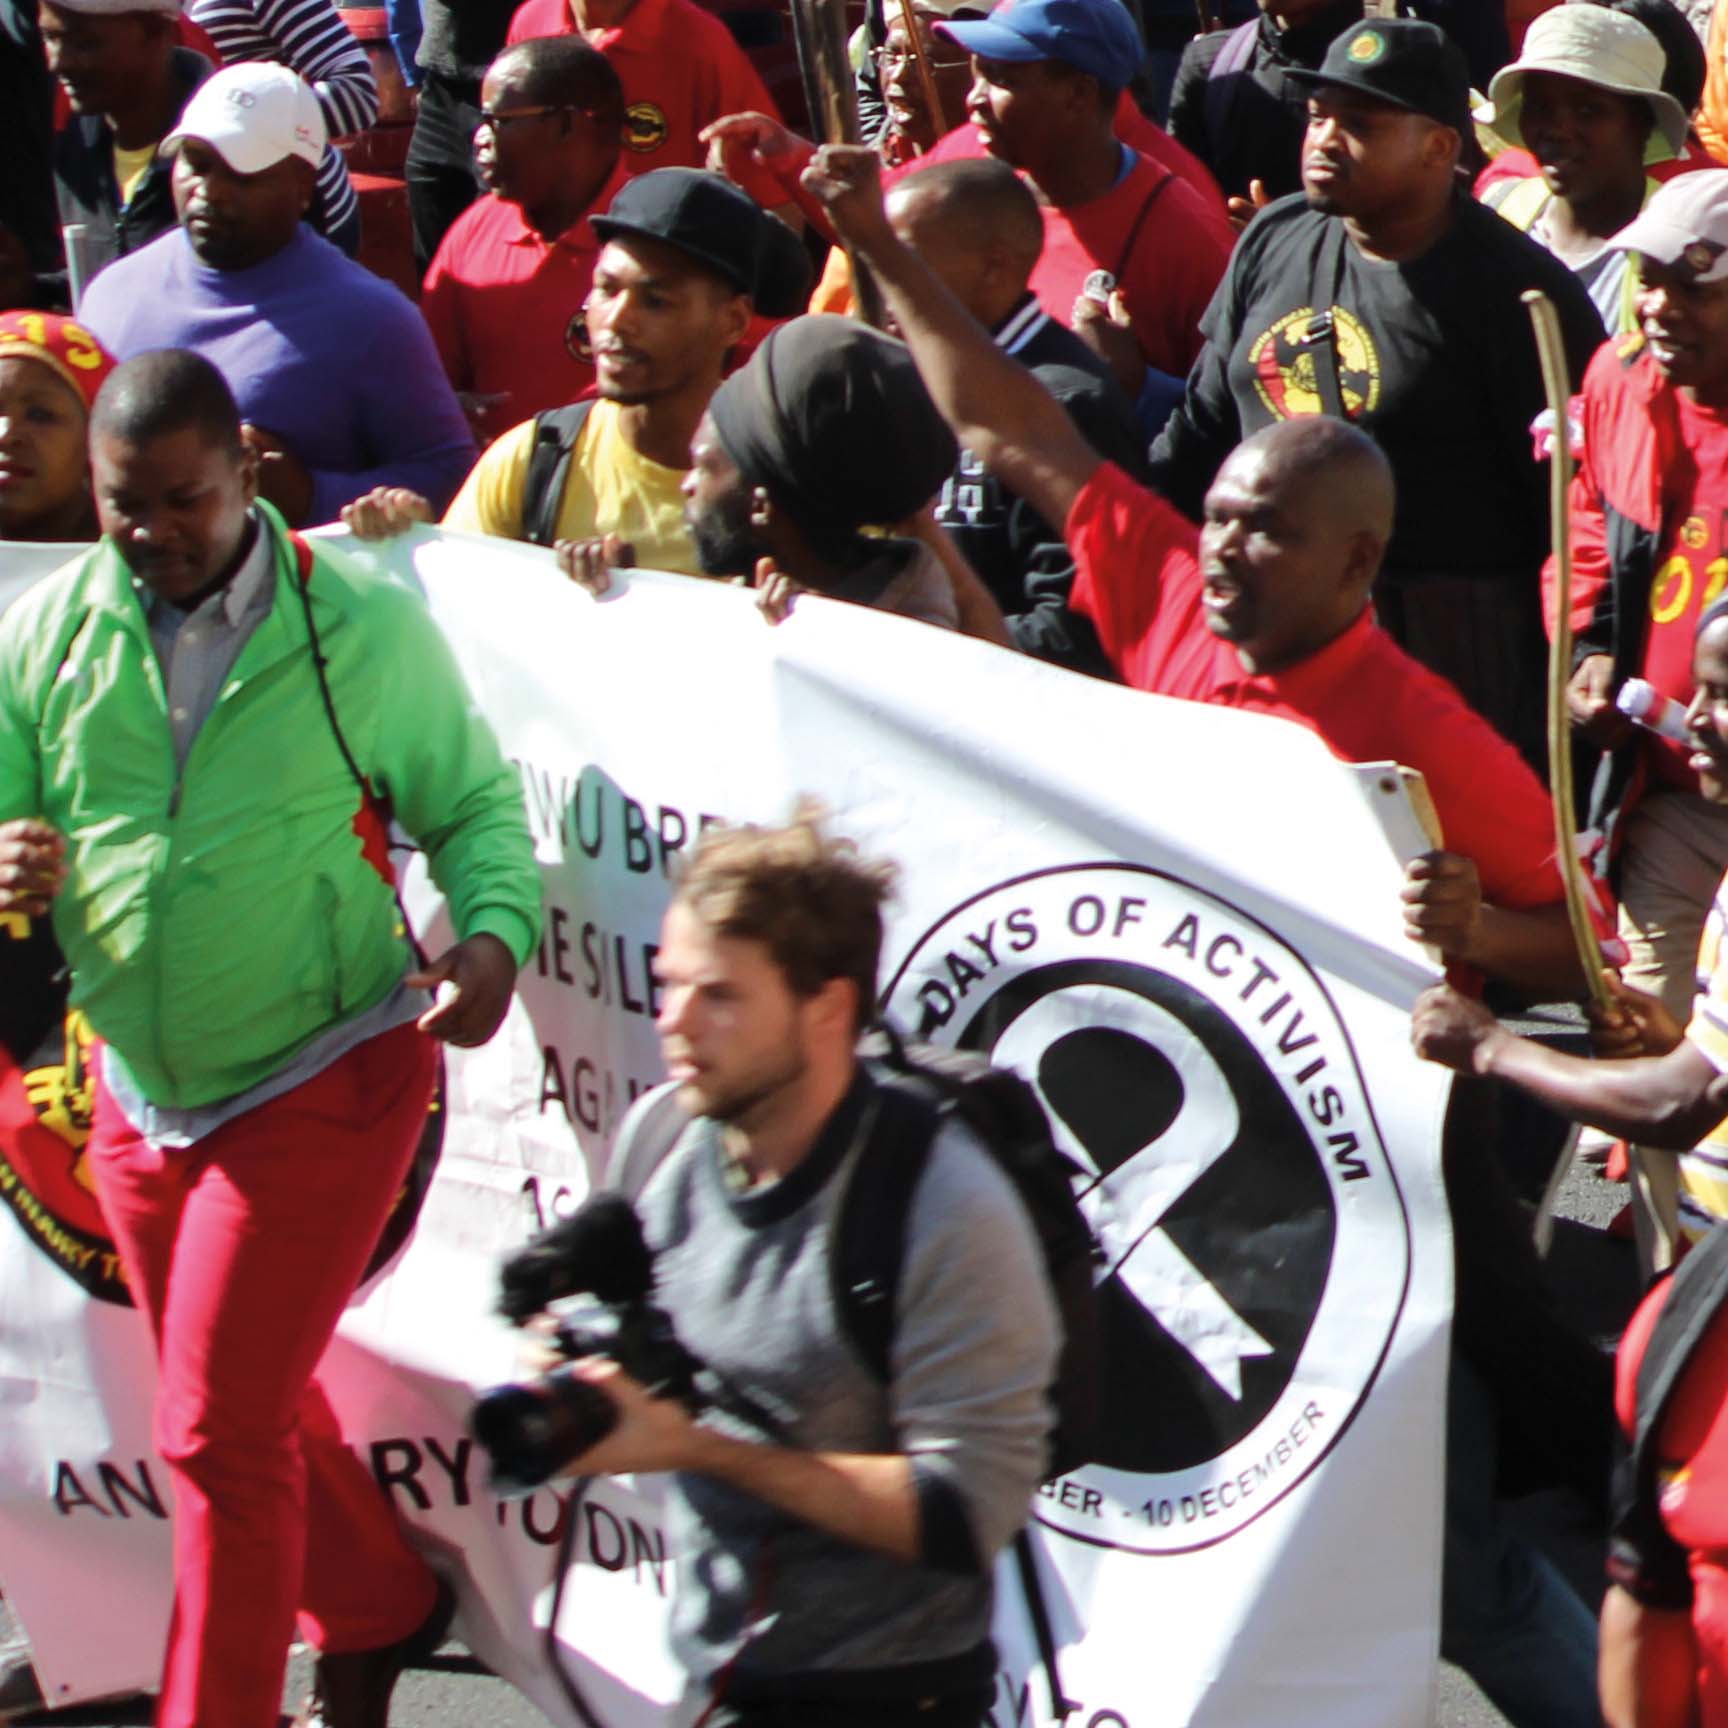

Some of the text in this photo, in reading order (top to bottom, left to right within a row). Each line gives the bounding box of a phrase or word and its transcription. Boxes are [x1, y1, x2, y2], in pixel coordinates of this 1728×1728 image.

[916, 894, 1372, 1184] DAYS OF ACTIVISM
[1141, 1499, 1173, 1528] 10
[1181, 1400, 1327, 1524] DECEMBER
